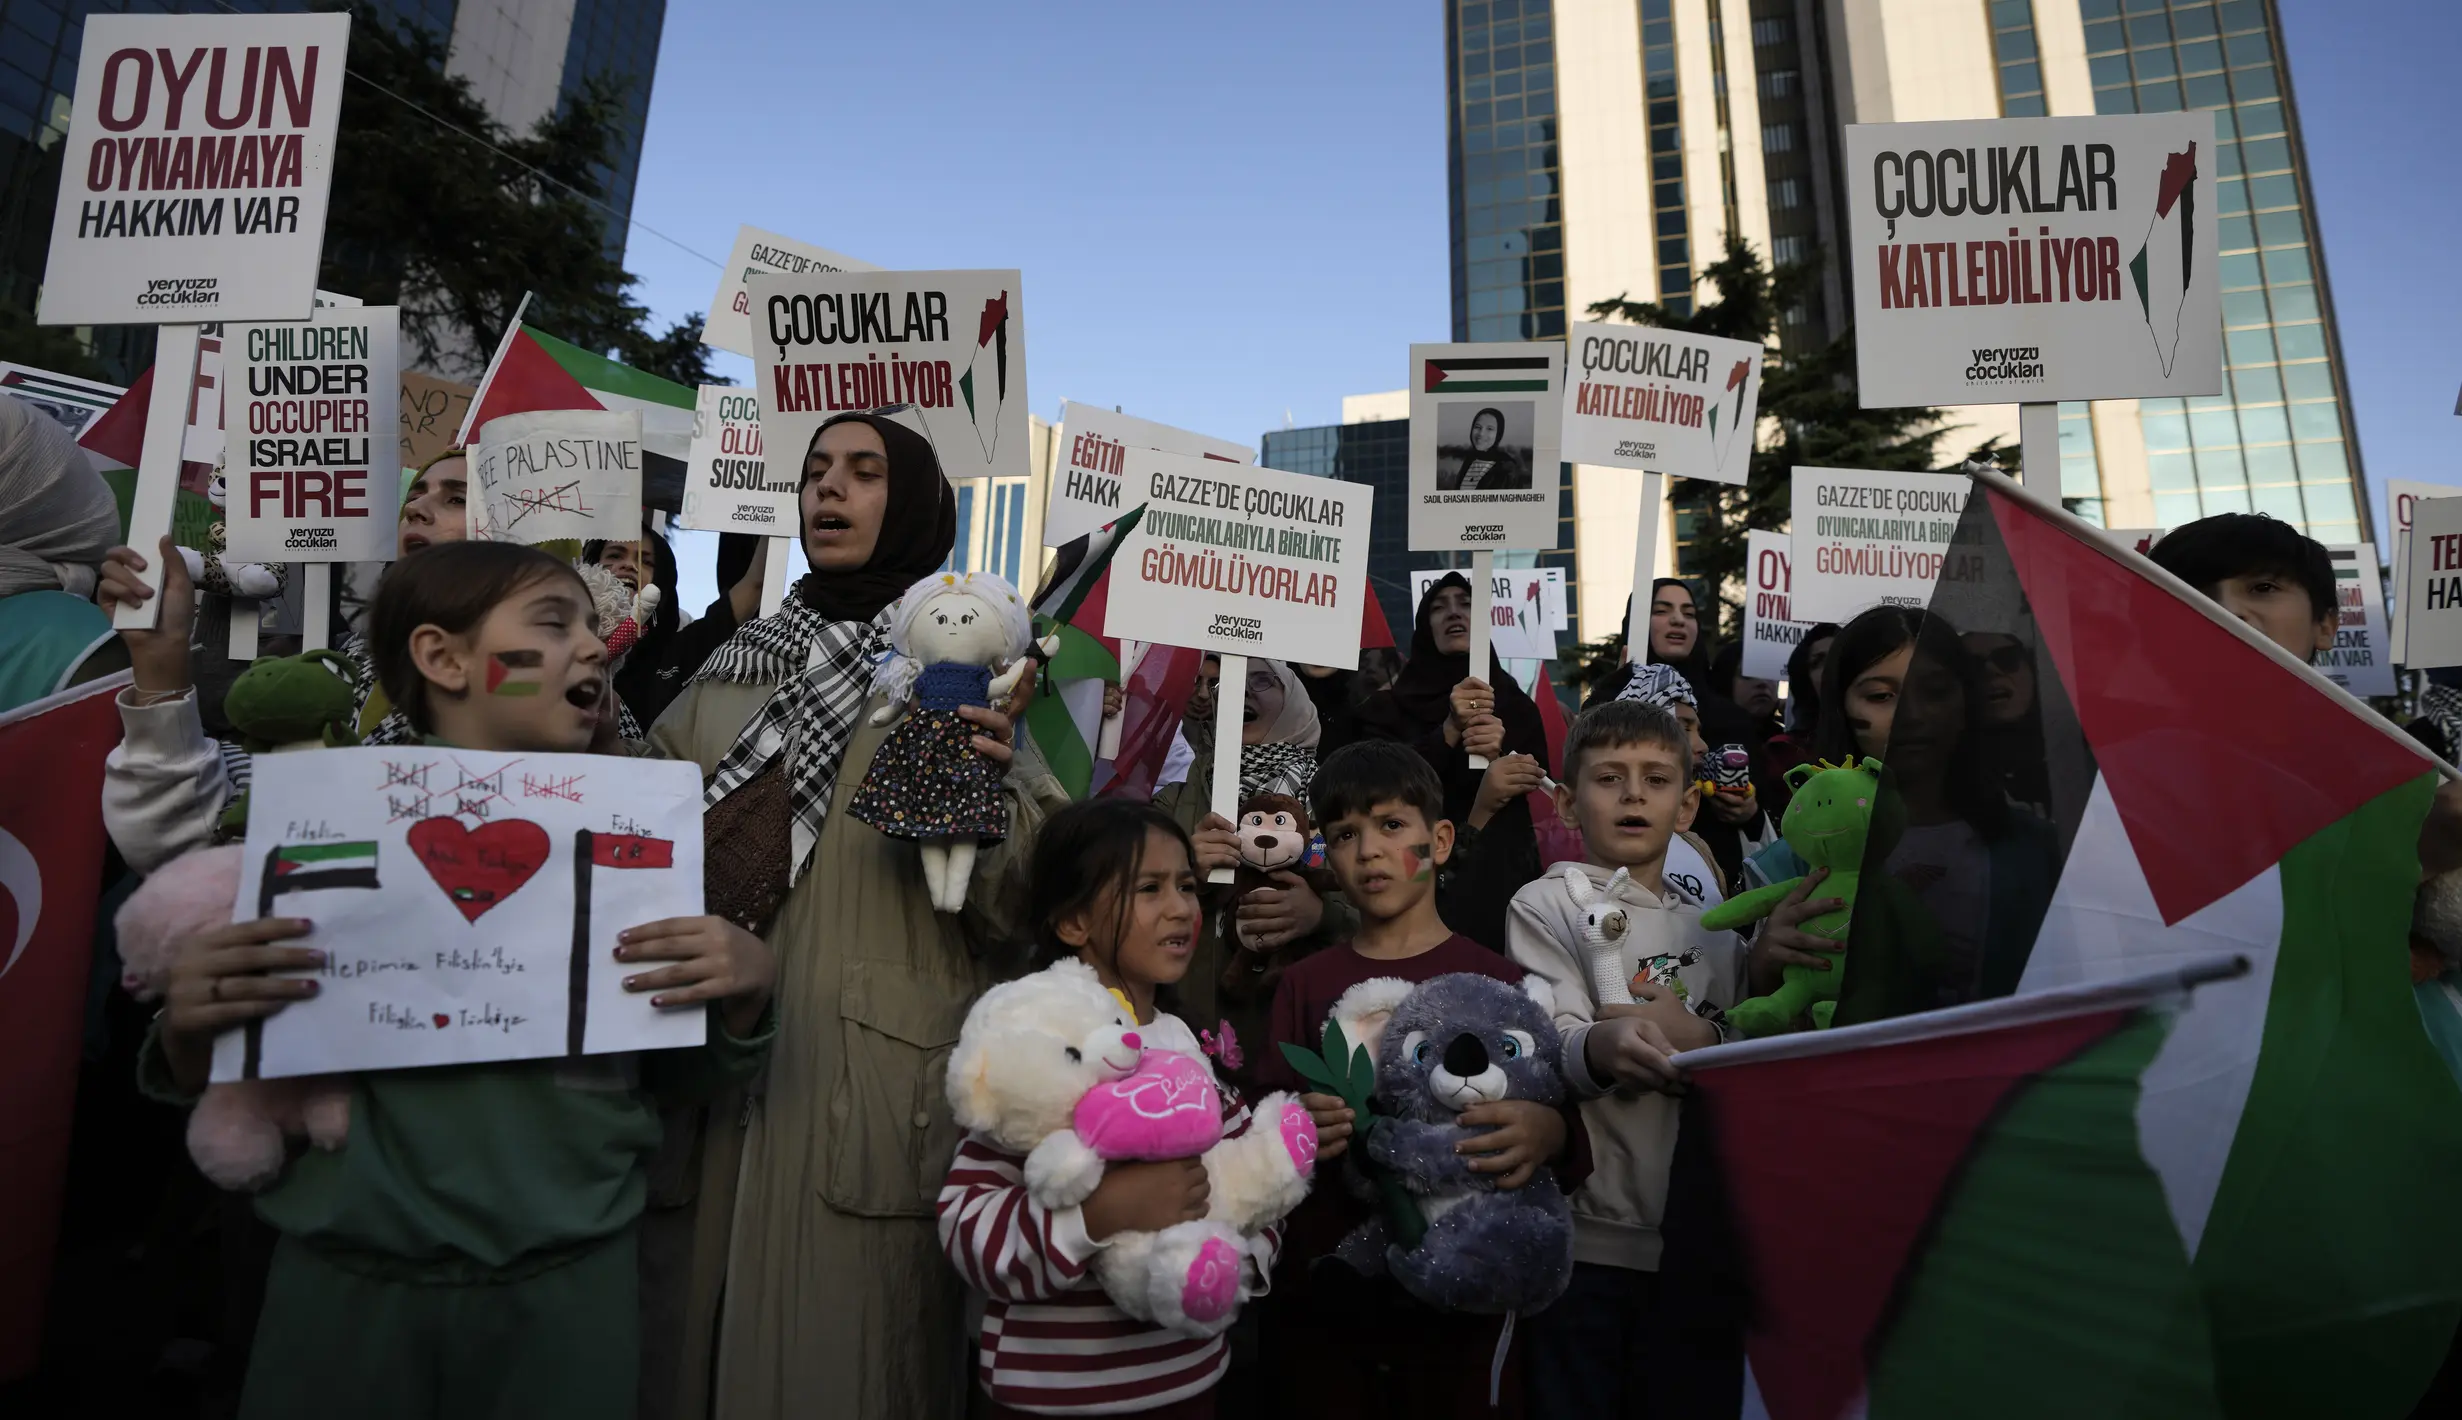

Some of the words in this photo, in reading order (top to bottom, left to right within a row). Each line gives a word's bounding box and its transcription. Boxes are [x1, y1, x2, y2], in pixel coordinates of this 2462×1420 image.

[97, 46, 319, 132] OYUN
[86, 134, 304, 192] OYNAMAYA
[1874, 143, 2117, 240] ÇOCUKLAR
[78, 197, 225, 238] HAKKIM
[234, 196, 300, 235] VAR
[1878, 226, 2121, 309] KATLEDİLİYOR
[247, 326, 368, 362] CHILDREN
[767, 291, 949, 361] ÇOCUKLAR
[1582, 336, 1710, 384] ÇOCUKLAR
[1972, 347, 2039, 367] yeryüzü
[248, 364, 368, 397] UNDER
[773, 352, 954, 413] KATLEDİLİYOR
[249, 399, 369, 434] OCCUPIER
[1576, 382, 1705, 429] KATLEDİLİYOR
[249, 438, 369, 467] ISRAELI
[506, 439, 638, 480] PALASTINE
[250, 470, 369, 519] FIRE
[1065, 470, 1122, 509] HAKK
[1150, 472, 1241, 511] GAZZE'DE
[1244, 487, 1344, 528] ÇOCUKLAR
[1817, 485, 1893, 510] GAZZE'DE
[1146, 509, 1275, 554] OYUNCAKLARIYLA
[1278, 526, 1341, 564] BİRLİKTE
[1816, 515, 1926, 543] OYUNCAKLARIYLA
[1141, 543, 1337, 608] GÖMÜLÜYORLAR
[1758, 549, 1791, 593] OY
[2342, 650, 2374, 667] VAR
